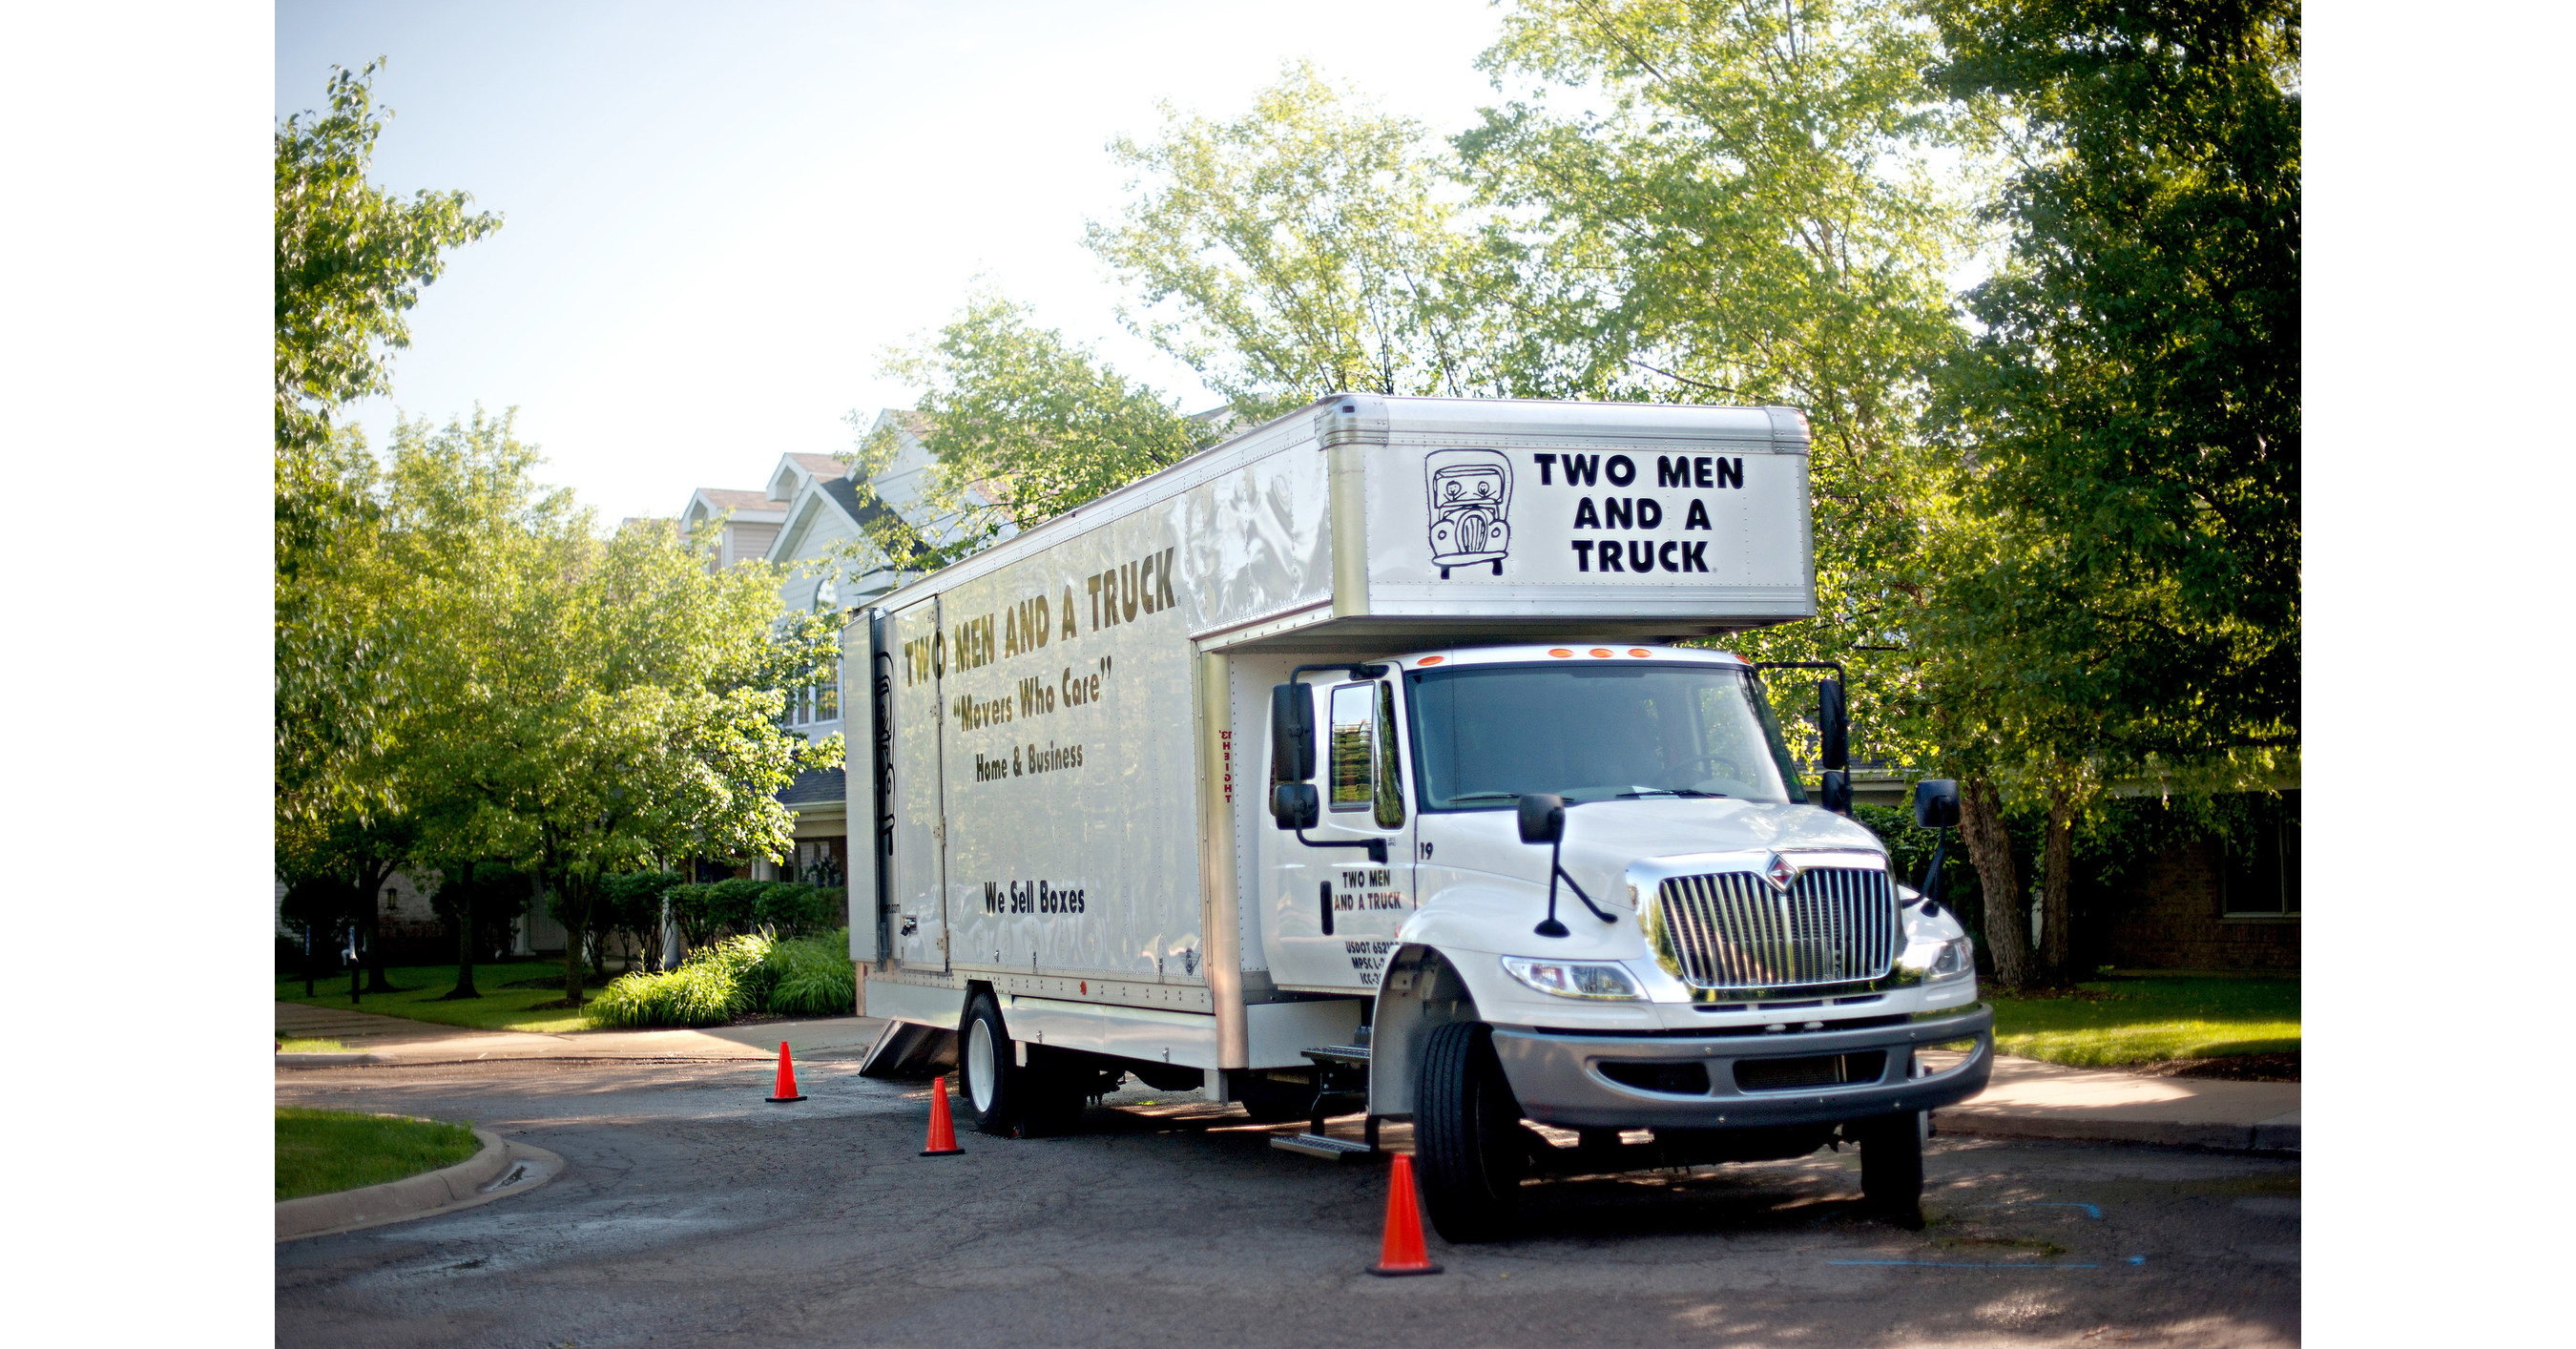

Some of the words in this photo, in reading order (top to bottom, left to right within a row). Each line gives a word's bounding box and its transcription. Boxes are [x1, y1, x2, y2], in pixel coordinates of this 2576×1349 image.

[1533, 452, 1636, 488] TWO
[1657, 454, 1744, 489] MEN
[1573, 496, 1663, 530] AND
[1685, 498, 1713, 531] A
[1571, 539, 1710, 573] TRUCK
[904, 630, 947, 688] TWO
[954, 612, 996, 674] MEN
[1005, 593, 1050, 659] AND
[1061, 585, 1077, 641] A
[1088, 546, 1175, 633] TRUCK
[953, 692, 1012, 733] “Movers
[1019, 674, 1054, 718] Who
[1062, 654, 1112, 709] Care”
[976, 751, 1008, 782] Home
[1013, 746, 1023, 777] &
[1028, 740, 1083, 775] Business
[1420, 841, 1434, 861] 19
[1342, 870, 1365, 888] TWO
[1369, 869, 1391, 887] MEN
[985, 881, 1006, 914] We
[1010, 879, 1034, 914] Sell
[1040, 880, 1086, 914] Boxes
[1334, 894, 1354, 911] AND
[1358, 893, 1365, 910] A
[1367, 891, 1402, 910] TRUCK
[1345, 941, 1371, 954] USDOT
[1372, 941, 1400, 955] 6521
[1351, 956, 1374, 970] MPSC
[1360, 972, 1381, 986] ICC-3
